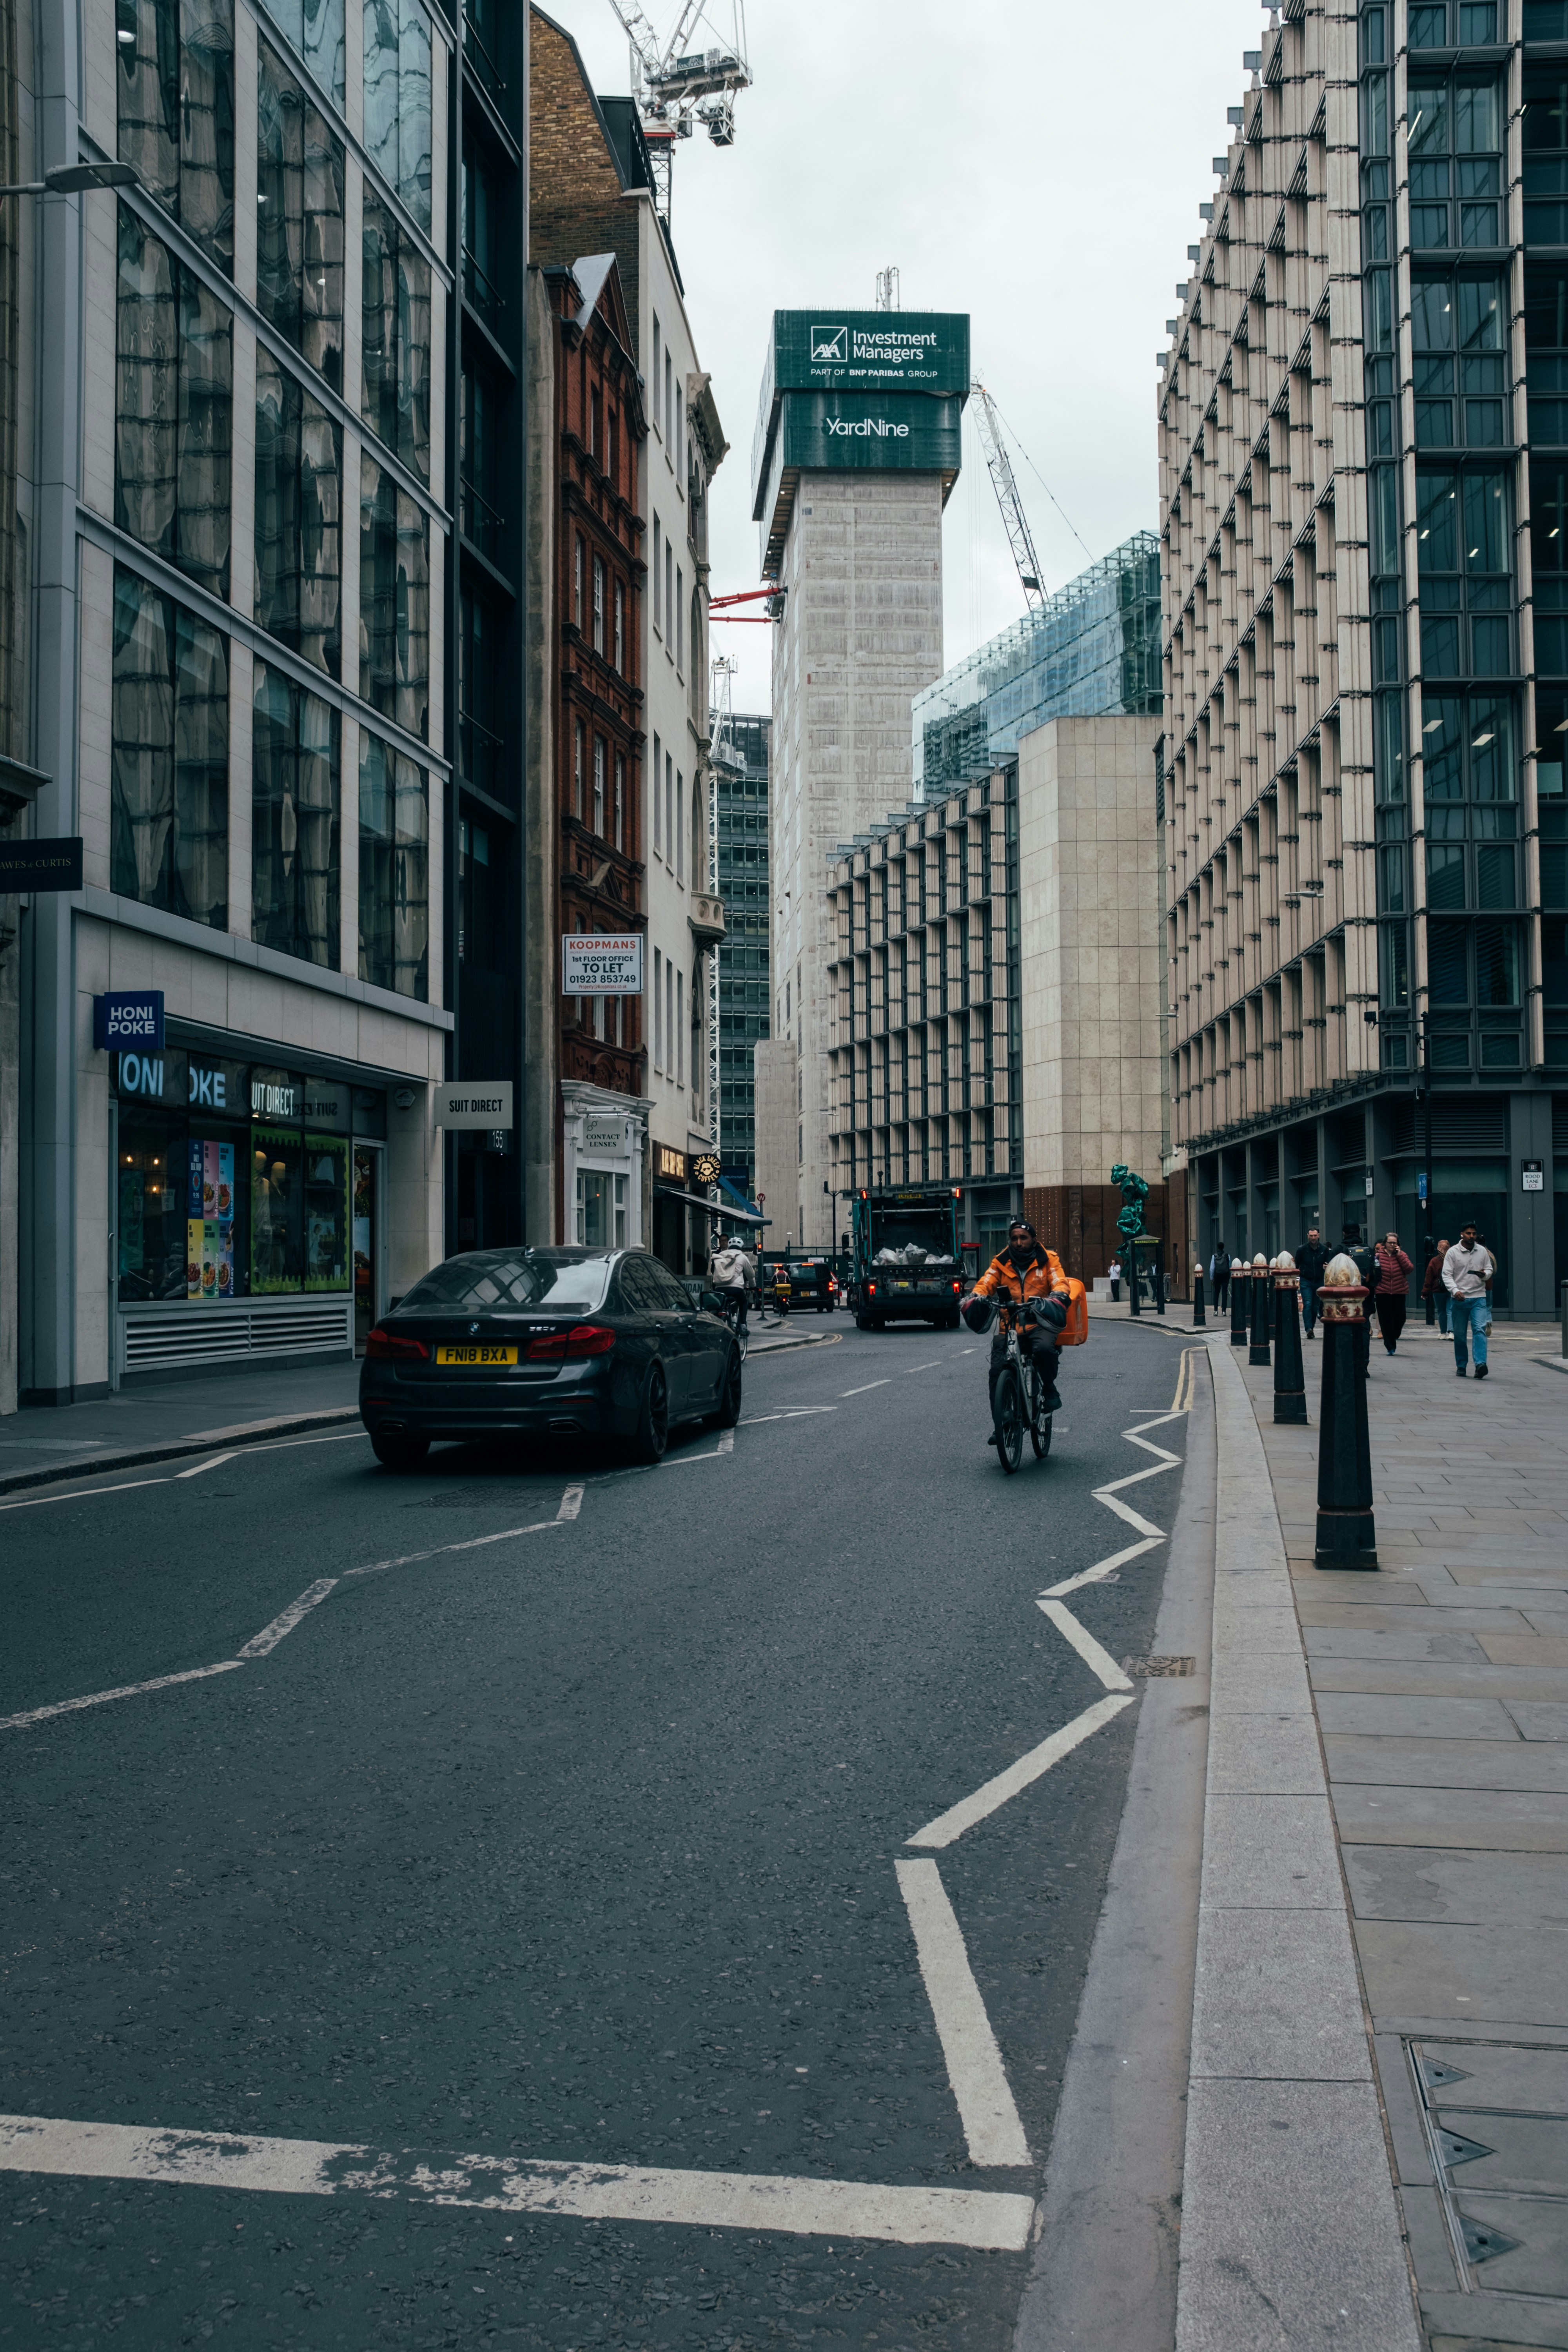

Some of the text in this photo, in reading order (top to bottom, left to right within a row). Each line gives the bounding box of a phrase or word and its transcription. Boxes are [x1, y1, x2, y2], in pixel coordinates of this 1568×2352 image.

[853, 330, 937, 346] Investment
[812, 344, 841, 358] AXA
[853, 345, 924, 363] Managers
[826, 417, 909, 437] YardNine
[36, 858, 71, 867] CURTIS
[570, 940, 636, 949] KOOPMANS
[582, 963, 624, 973] TO LET
[570, 975, 636, 983] 01923 853749
[111, 1006, 153, 1020] HONI
[108, 1021, 155, 1034] POKE
[119, 1052, 164, 1097] ONI
[251, 1082, 294, 1116] UIT DIRECT
[449, 1099, 503, 1112] SUIT DIRECT
[492, 1130, 503, 1149] 155
[693, 1155, 721, 1183] BLACK SHEEP COFFEE
[446, 1348, 507, 1361] FN18 BXA
